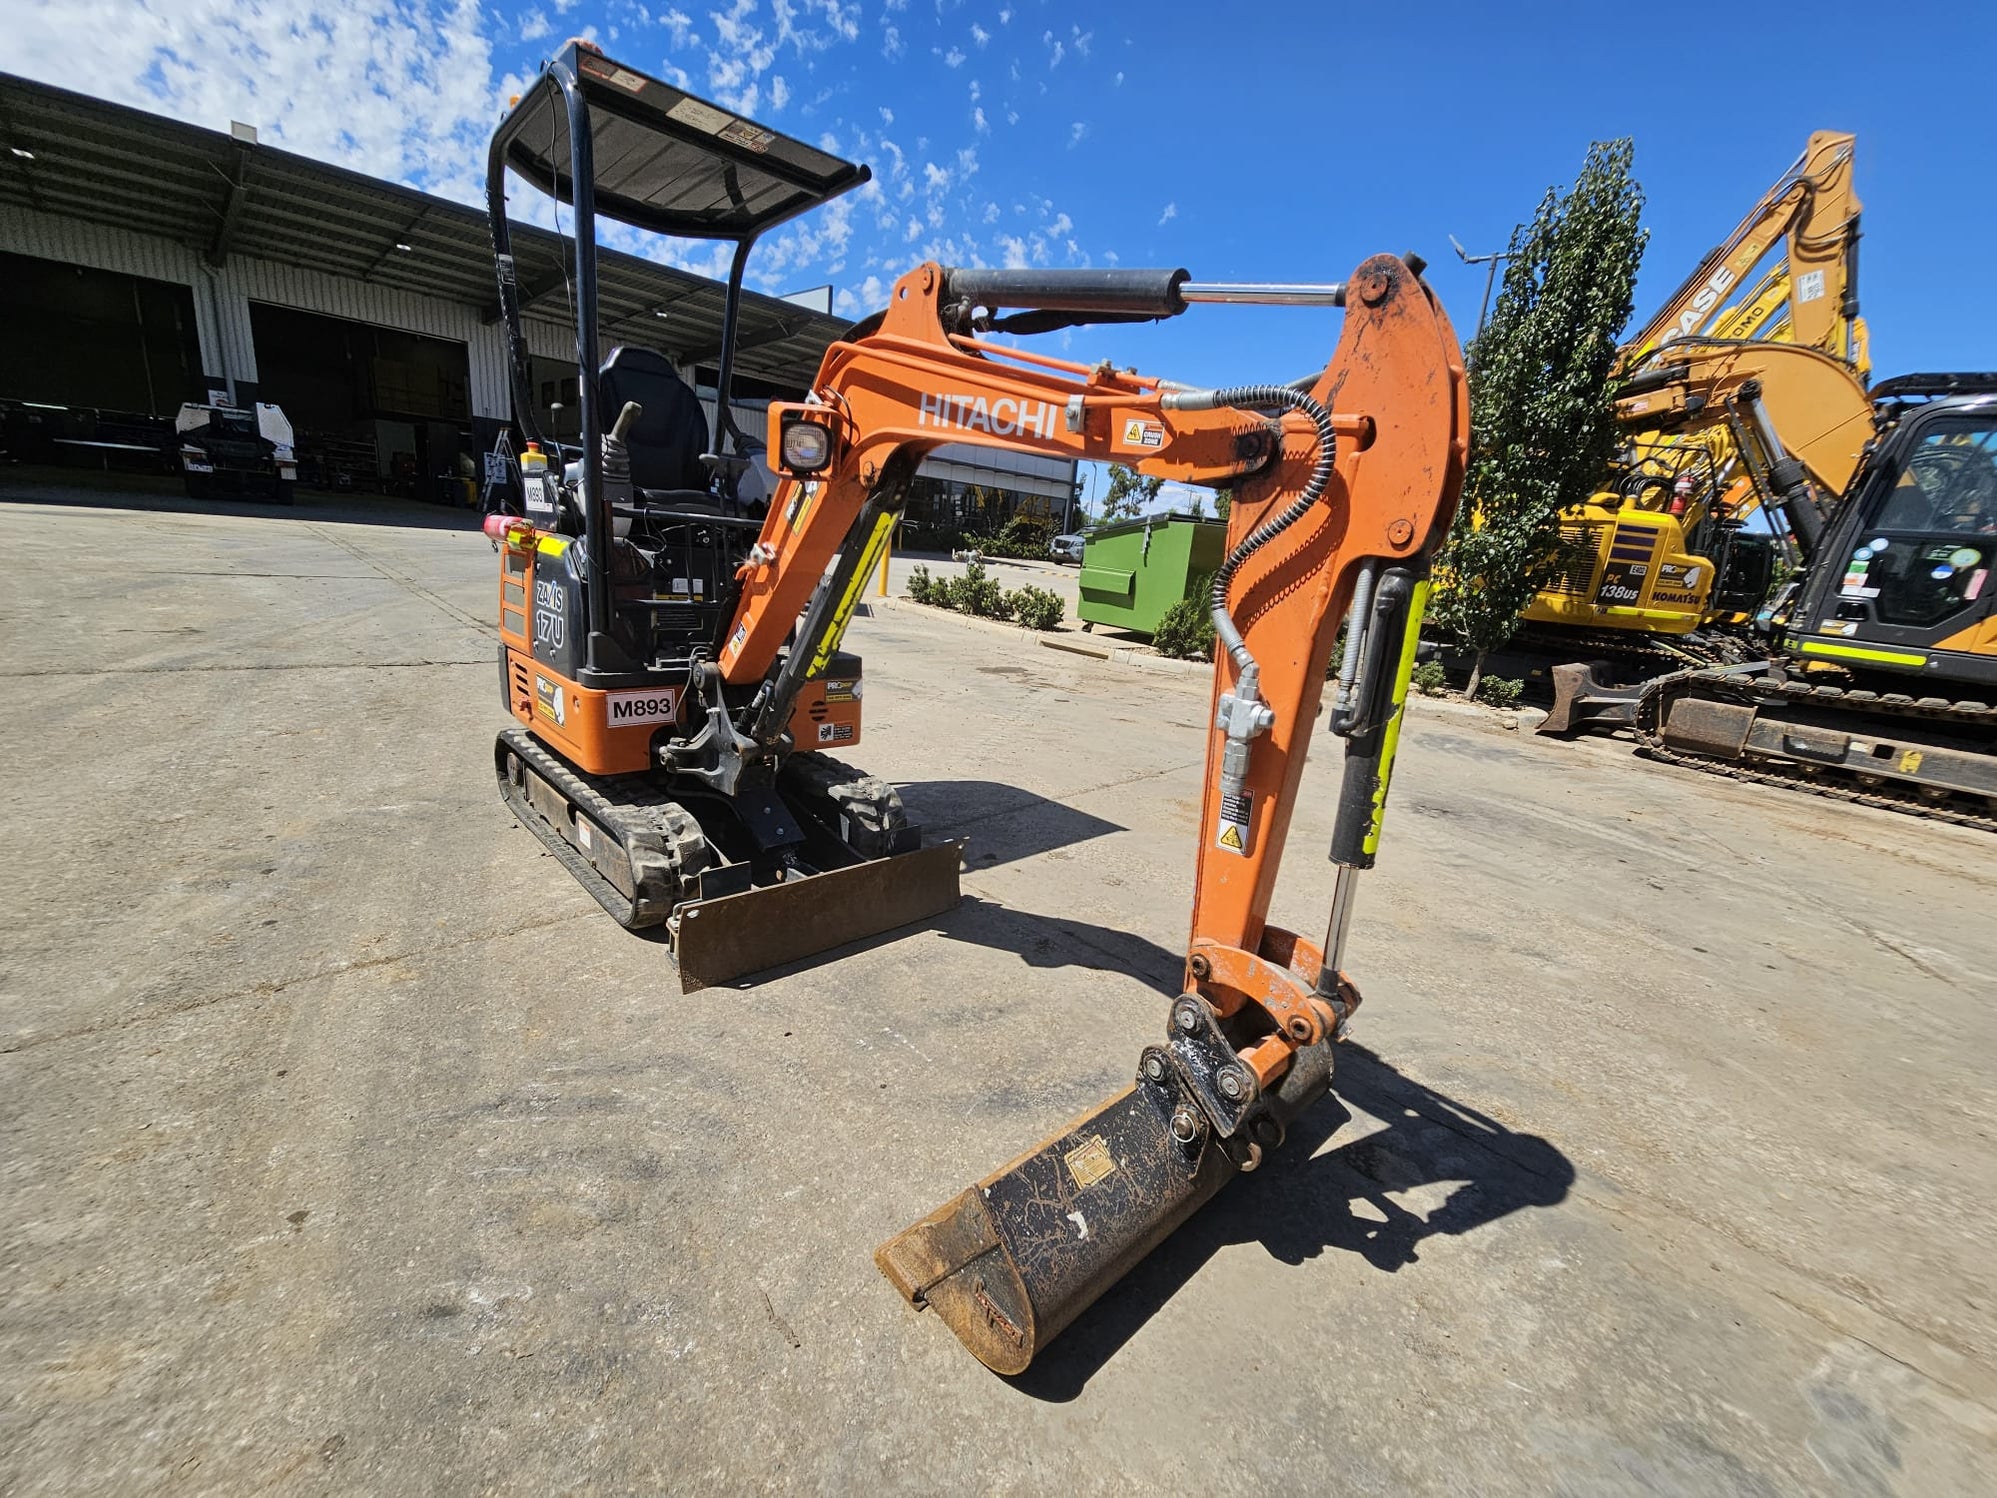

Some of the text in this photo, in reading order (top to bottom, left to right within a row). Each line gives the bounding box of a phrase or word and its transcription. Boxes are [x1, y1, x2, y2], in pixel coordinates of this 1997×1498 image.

[1661, 266, 1736, 351] CASE
[1728, 306, 1764, 339] OMO
[918, 391, 1058, 439] HITACHI
[526, 486, 543, 503] M893
[1600, 584, 1639, 600] 138US
[1606, 573, 1621, 585] PC
[536, 580, 563, 612] ZAXIS
[1652, 592, 1700, 605] KOMATSU
[536, 609, 565, 649] 17U
[613, 698, 671, 719] M893
